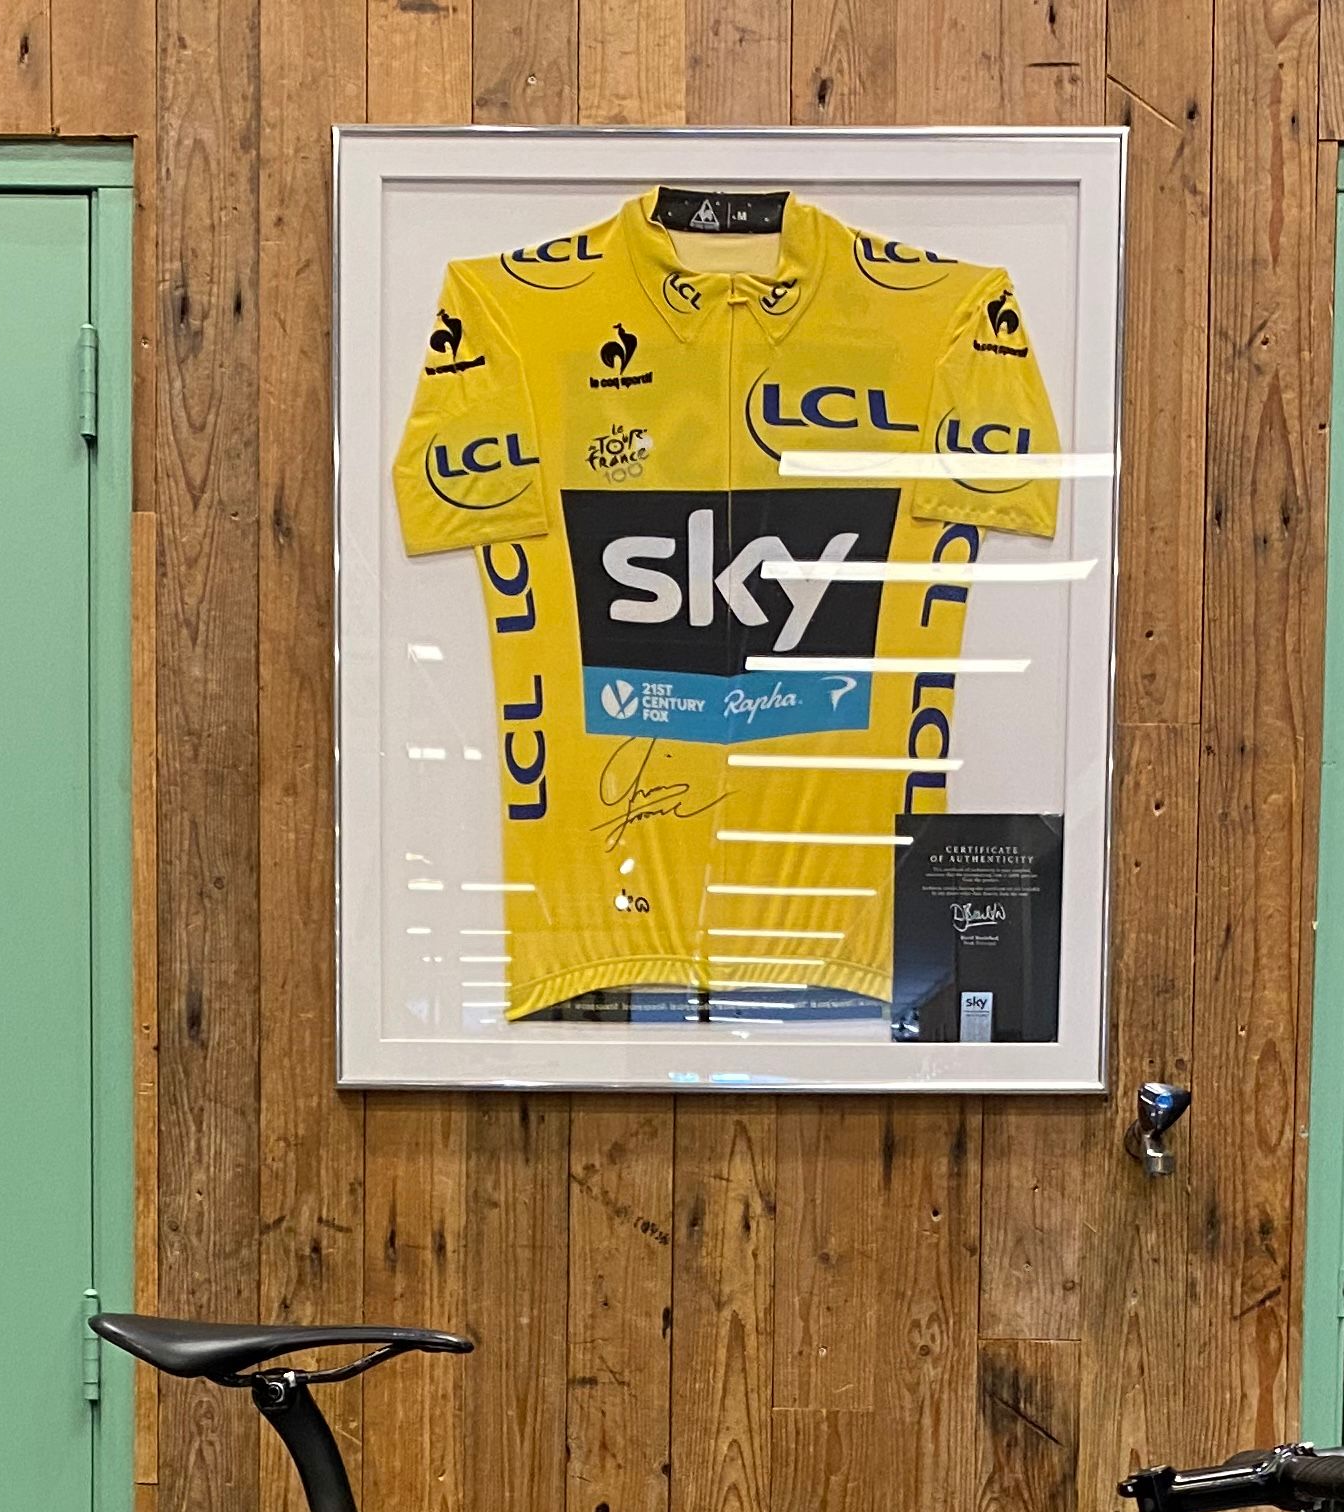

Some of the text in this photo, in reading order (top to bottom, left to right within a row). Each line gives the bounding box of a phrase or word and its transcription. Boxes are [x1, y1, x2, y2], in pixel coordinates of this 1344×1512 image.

[737, 211, 747, 222] M
[511, 234, 603, 263] LCL
[668, 272, 703, 311] LCL
[760, 277, 798, 309] LCL
[762, 383, 920, 433] LCL
[434, 432, 540, 478] LCL
[604, 462, 644, 485] 100
[482, 543, 537, 634] LC
[600, 508, 860, 653] sky
[921, 523, 980, 629] CL
[641, 682, 674, 697] 21ST
[642, 695, 706, 713] CENTURY
[723, 681, 800, 725] Rapha
[642, 708, 670, 723] FOX
[503, 674, 549, 821] LCL
[902, 670, 957, 815] LCL
[929, 854, 1035, 865] OF AUTHENTICITY
[945, 845, 1019, 855] CERTIFICATE
[966, 996, 988, 1010] sky
